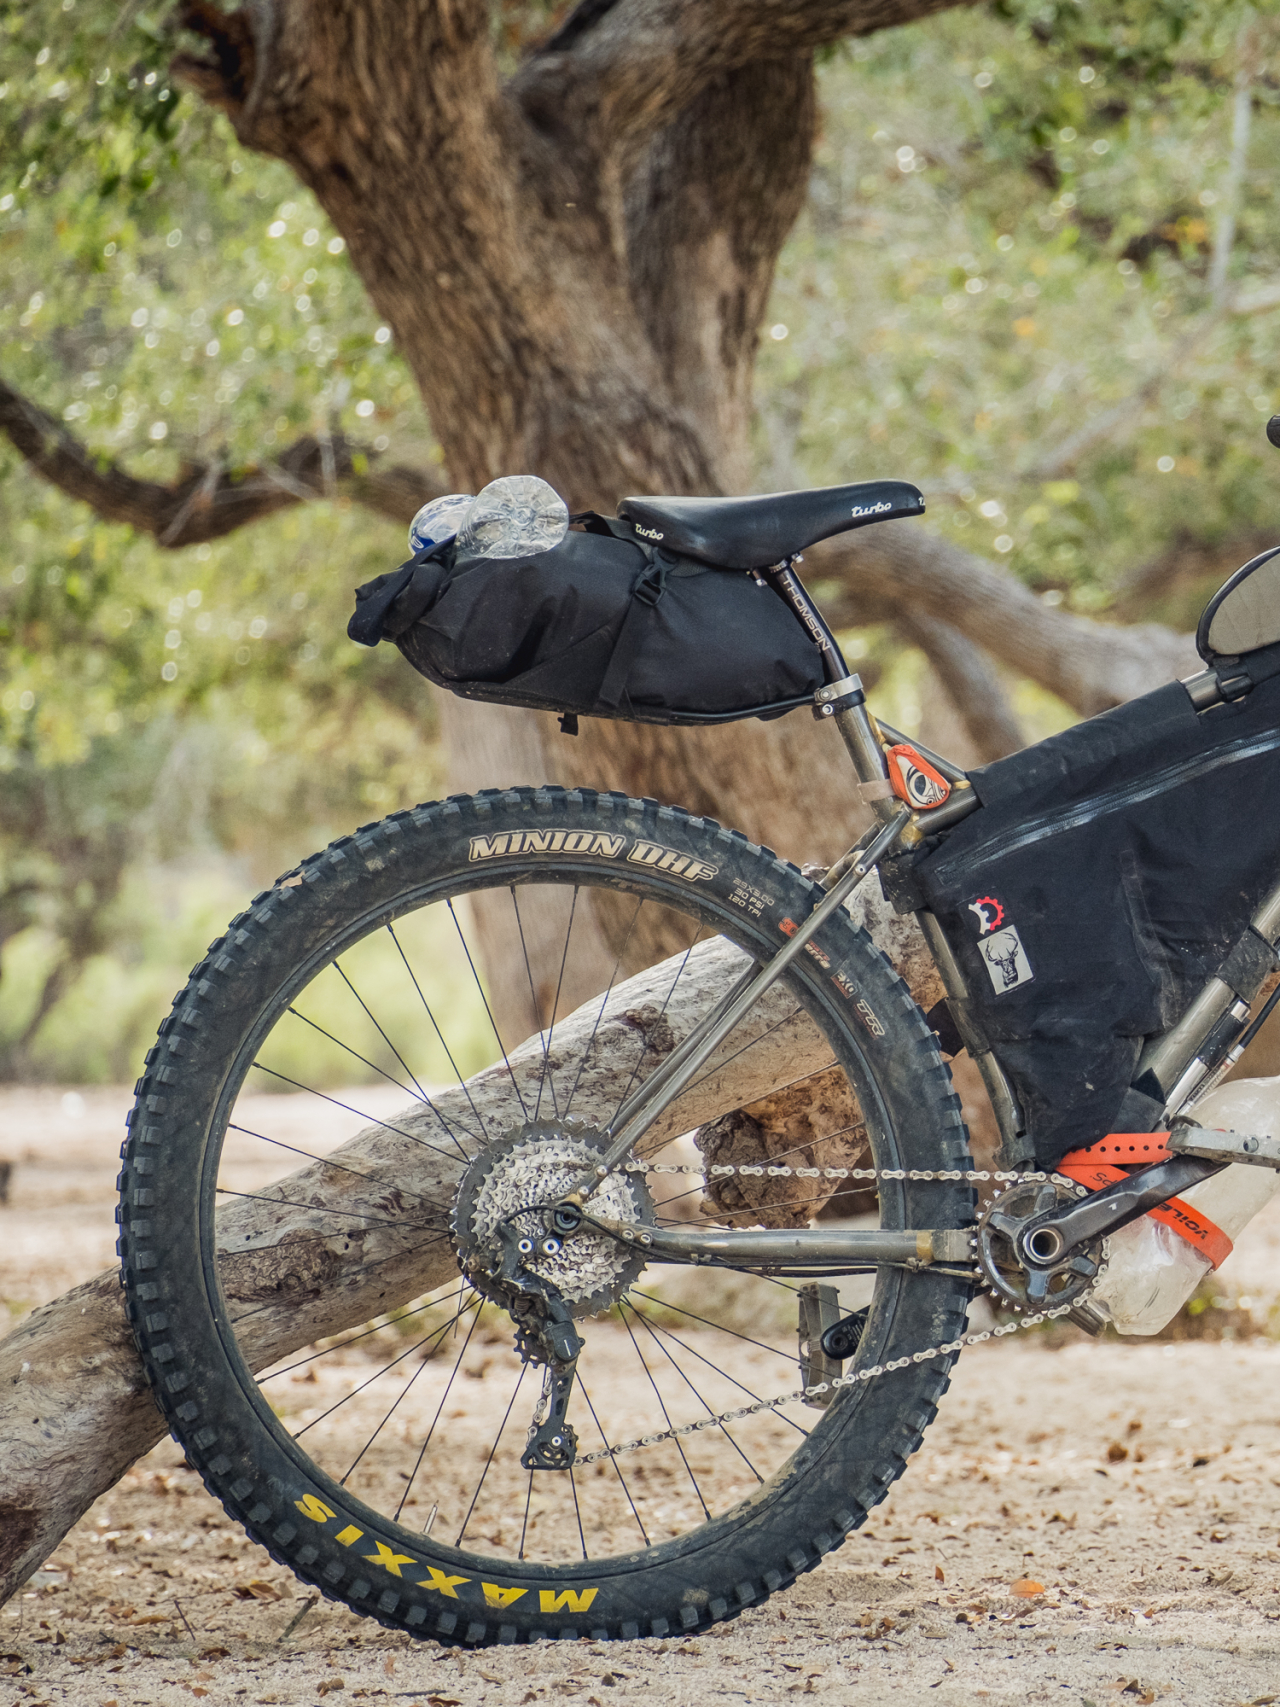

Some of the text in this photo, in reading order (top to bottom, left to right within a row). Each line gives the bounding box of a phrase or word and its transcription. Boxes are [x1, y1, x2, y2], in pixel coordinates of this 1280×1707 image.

[851, 501, 892, 518] turbo
[635, 523, 664, 540] turbo
[783, 575, 831, 651] THOMSON
[469, 828, 719, 882] MINION DHF
[728, 893, 762, 917] 120 TPI
[734, 888, 765, 910] 30 PSI
[856, 999, 885, 1036] TR
[294, 1493, 599, 1613] MAXXIS
